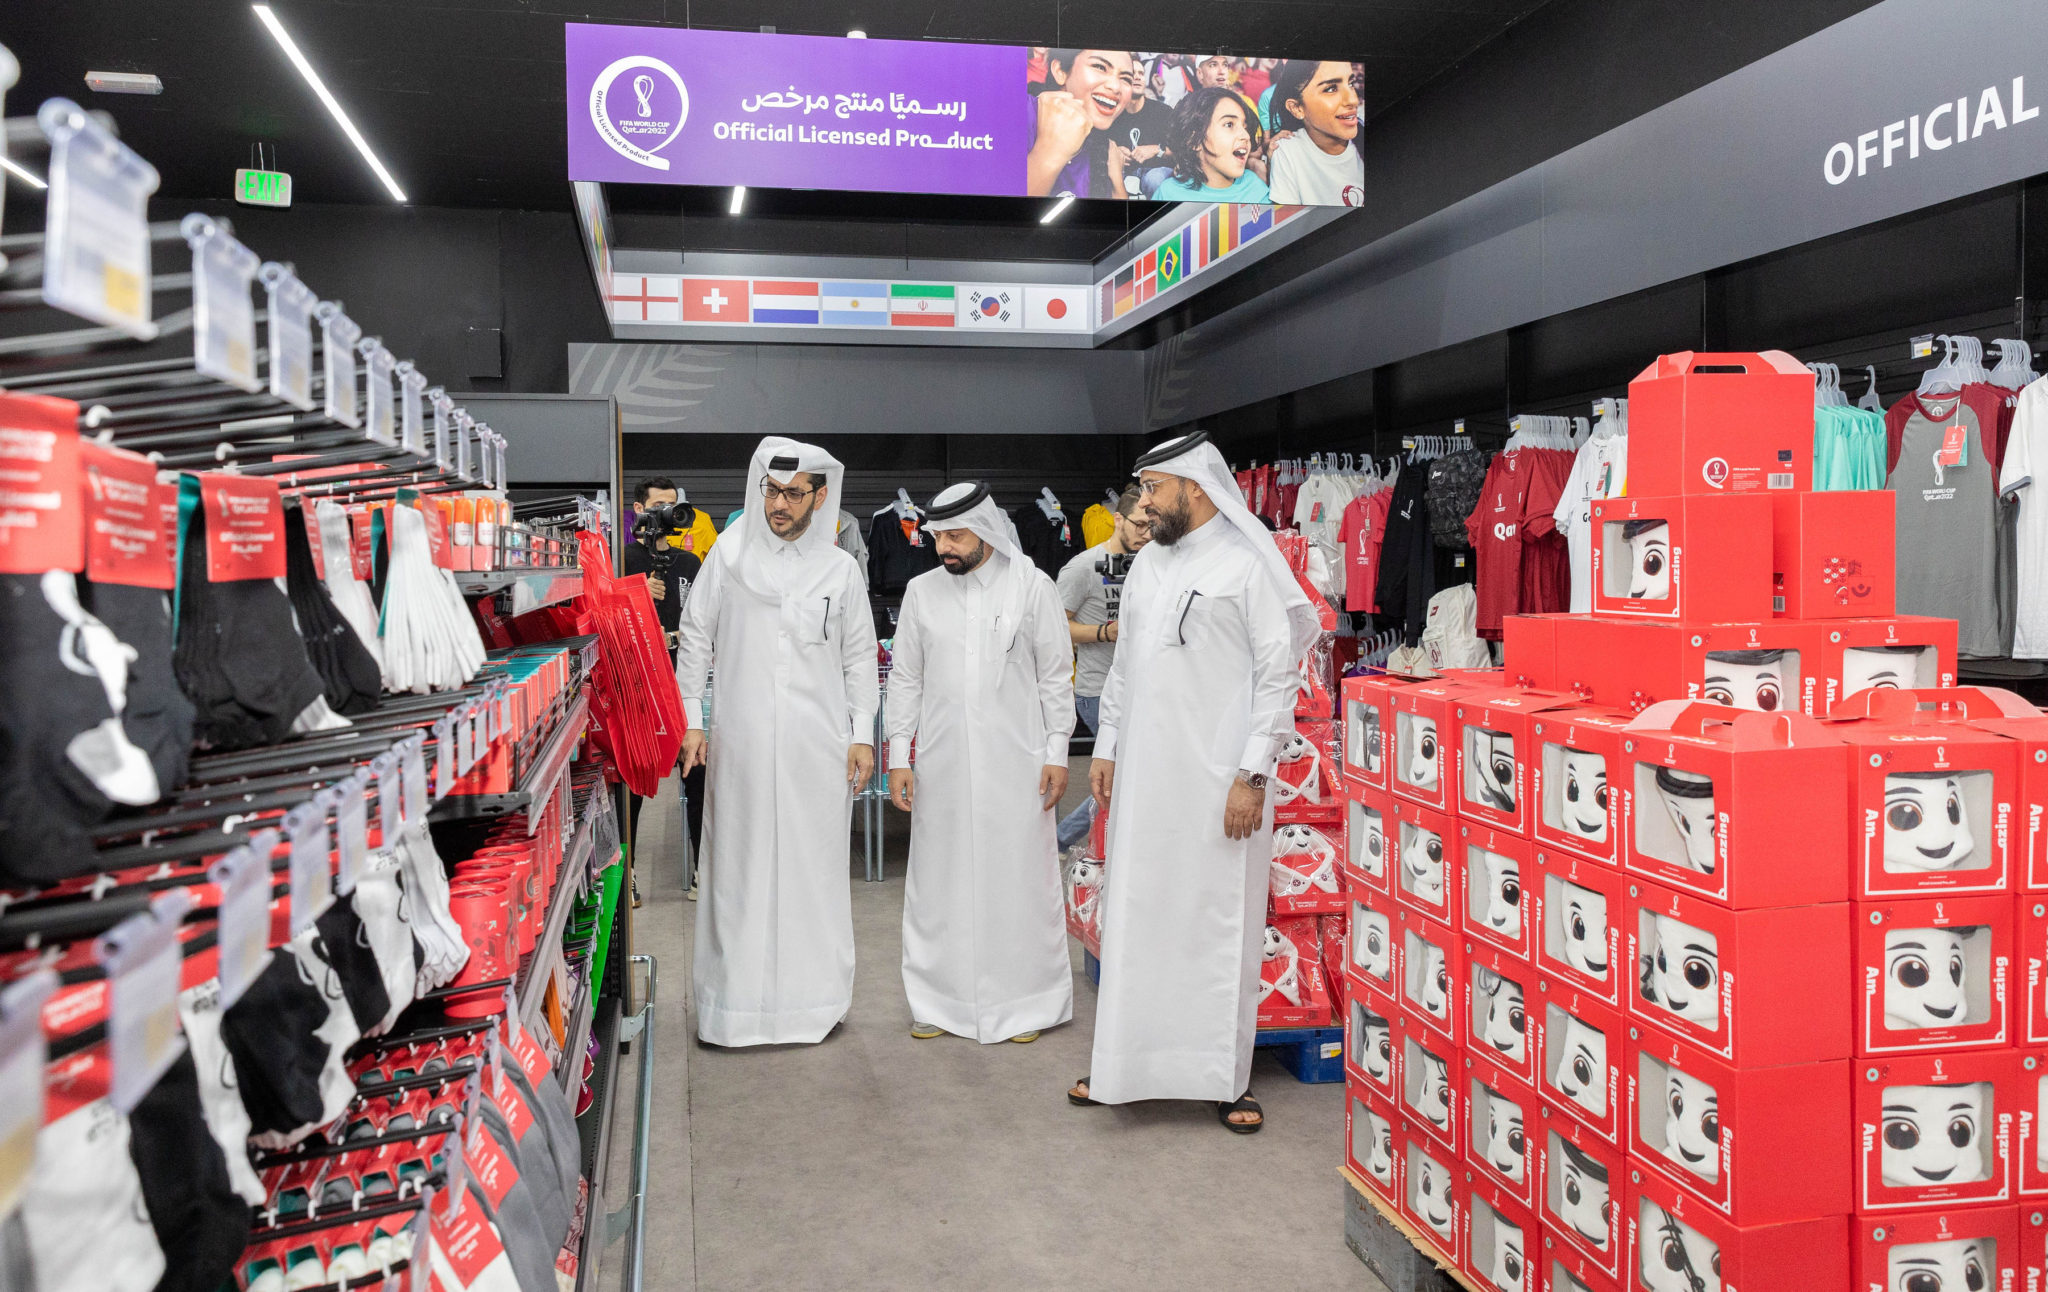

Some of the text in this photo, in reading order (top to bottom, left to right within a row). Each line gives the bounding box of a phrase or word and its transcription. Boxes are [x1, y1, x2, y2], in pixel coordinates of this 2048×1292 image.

[741, 85, 829, 115] مرخص
[834, 91, 885, 119] منتج
[595, 90, 650, 161] Official Licensed Product
[713, 121, 993, 150] Official Licensed Product
[1823, 75, 2040, 185] OFFICIAL
[245, 171, 283, 202] EXIT
[1593, 548, 1600, 570] Am
[1671, 546, 1682, 585] azing
[1802, 677, 1816, 715] azing
[1826, 677, 1838, 705] Am
[1456, 749, 1463, 771] Am
[1517, 762, 1525, 800] azing
[1534, 768, 1541, 792] Am
[1609, 786, 1619, 828] azing
[1624, 789, 1632, 816] Am
[1865, 809, 1879, 838] Am
[1995, 802, 2011, 848] azing
[2029, 803, 2044, 833] Am
[1717, 811, 1729, 858] azing
[1444, 861, 1452, 894] azing
[1462, 866, 1467, 889] Am
[1522, 889, 1530, 927] azing
[1535, 897, 1543, 921] Am
[1609, 927, 1619, 969] azing
[1628, 933, 1636, 961] Am
[1866, 966, 1880, 996] Am
[1993, 956, 2009, 1002] azing
[2028, 957, 2042, 987] Am
[1465, 983, 1471, 1005] Am
[1721, 970, 1734, 1017] azing
[1527, 1015, 1535, 1052] azing
[1537, 1024, 1544, 1048] Am
[1608, 1065, 1619, 1106] azing
[1628, 1074, 1636, 1102] Am
[1449, 1088, 1457, 1123] azing
[1464, 1097, 1470, 1120] Am
[1863, 1122, 1876, 1152] Am
[1996, 1113, 2012, 1159] azing
[2019, 1110, 2033, 1139] Am
[1526, 1138, 1534, 1174] azing
[1539, 1148, 1547, 1174] Am
[1720, 1126, 1733, 1173] azing
[1464, 1210, 1470, 1233] Am
[1612, 1200, 1620, 1241] azing
[1628, 1216, 1637, 1245] Am
[1526, 1259, 1535, 1292] zing
